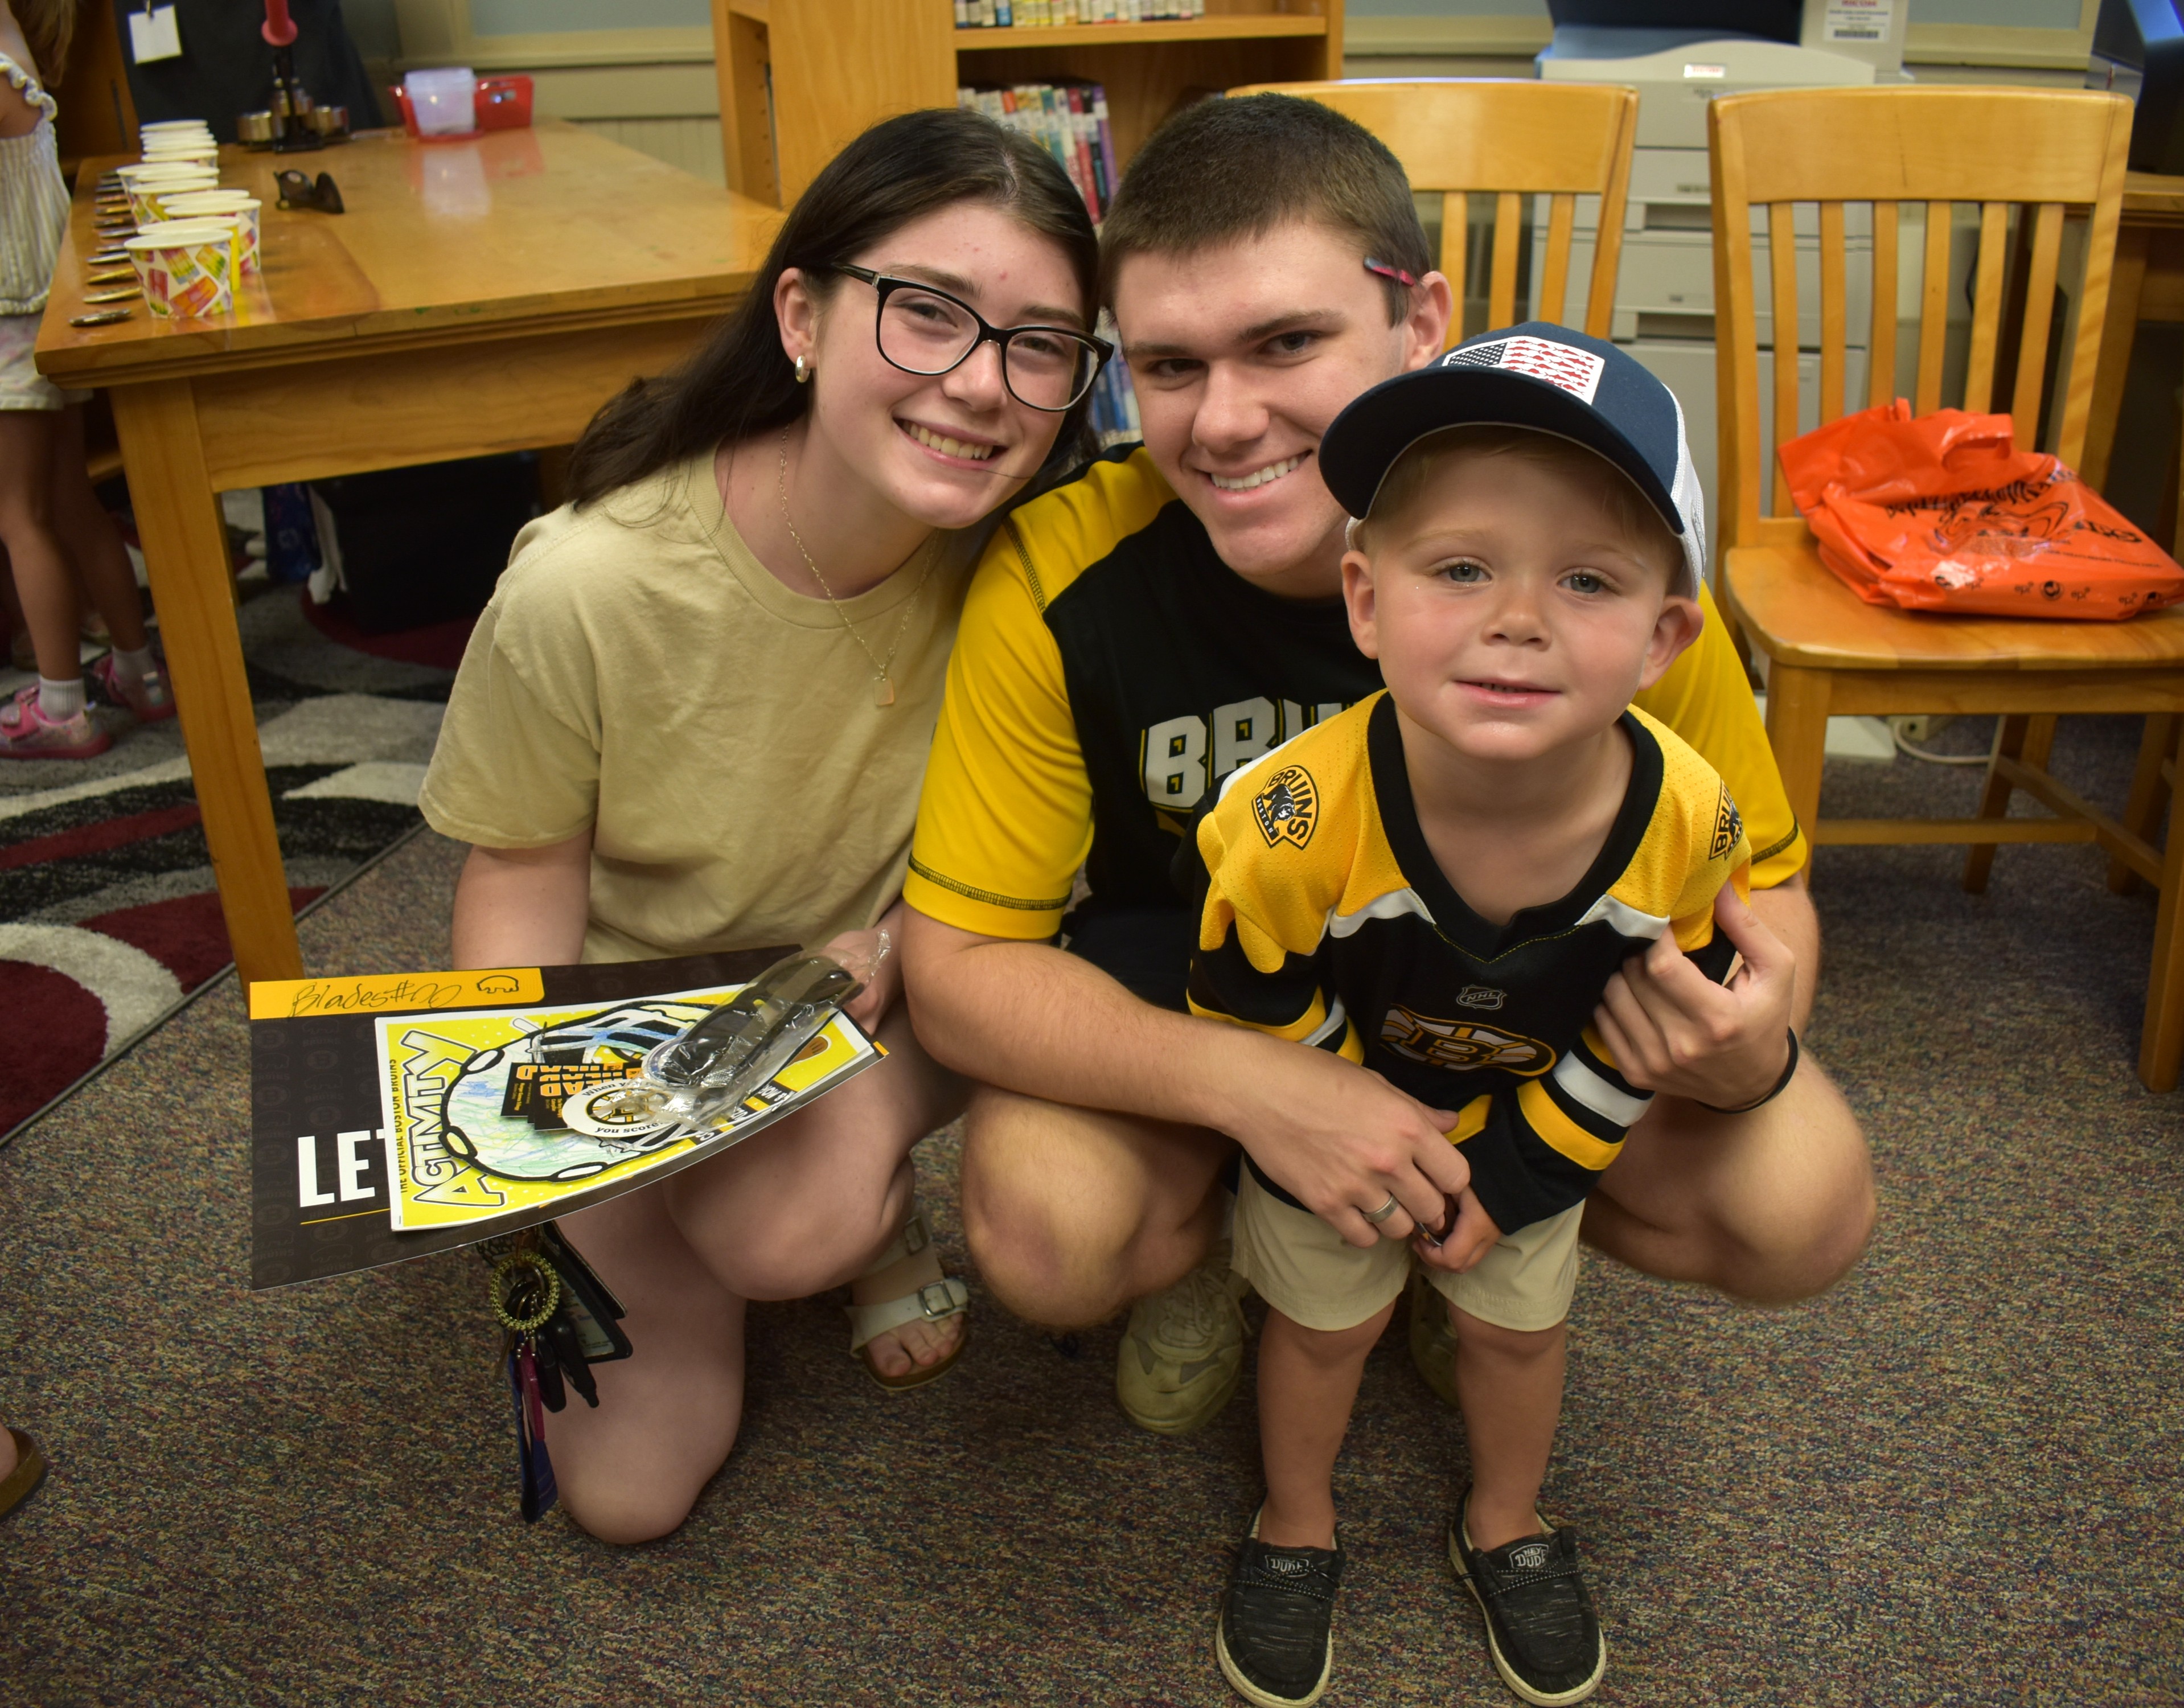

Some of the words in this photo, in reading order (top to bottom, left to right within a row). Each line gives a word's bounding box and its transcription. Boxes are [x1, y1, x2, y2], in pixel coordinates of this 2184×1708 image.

[1267, 770, 1313, 840] BRUINS
[1467, 992, 1497, 1001] NHL
[389, 1059, 399, 1093] BRUINS
[581, 1082, 615, 1097] When
[758, 1085, 782, 1099] MOR
[393, 1095, 403, 1134] BOSTON
[401, 1030, 504, 1206] ACTIVITY
[297, 1129, 386, 1208] LE
[396, 1135, 407, 1177] OFFICIAL
[400, 1178, 408, 1193] THE
[1515, 1549, 1547, 1567] DUDE
[1522, 1546, 1542, 1555] HEY
